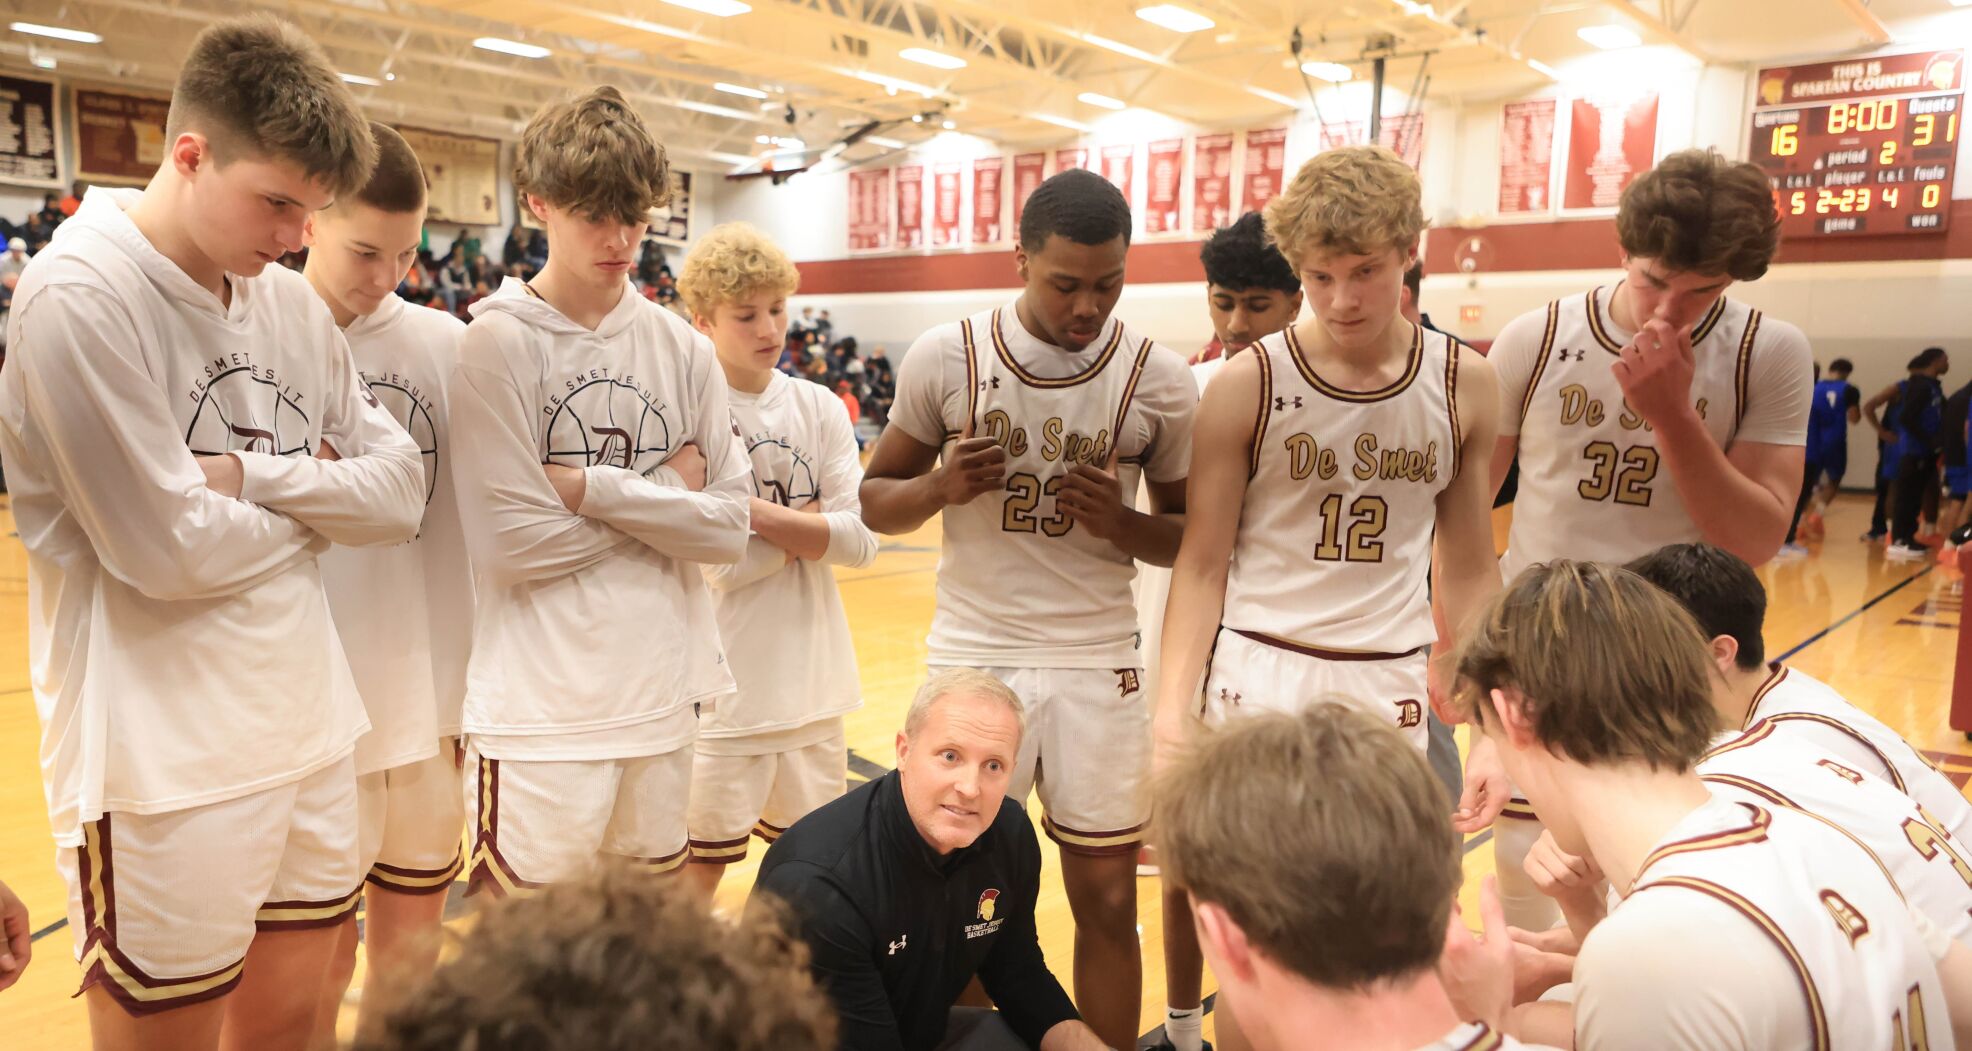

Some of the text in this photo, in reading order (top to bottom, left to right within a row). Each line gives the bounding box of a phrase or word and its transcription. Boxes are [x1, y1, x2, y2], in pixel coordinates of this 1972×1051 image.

[1791, 71, 1922, 97] SPARTAN COUNTRY
[1832, 61, 1882, 80] THIS IS
[1828, 99, 1898, 134] 8:00
[1912, 114, 1956, 146] 31
[1771, 124, 1798, 156] 16
[1879, 141, 1897, 165] 2
[1827, 148, 1868, 168] period
[1790, 191, 1806, 215] 5
[1882, 187, 1899, 209] 4
[1921, 184, 1940, 209] 0
[204, 352, 250, 378] SMET
[380, 372, 433, 411] JESUIT
[543, 394, 561, 416] DE
[566, 368, 609, 391] SMET
[1559, 383, 1605, 428] De
[984, 409, 1028, 457] De
[1284, 432, 1438, 483] De Smet
[1577, 440, 1660, 507] 32
[1314, 493, 1389, 563] 12
